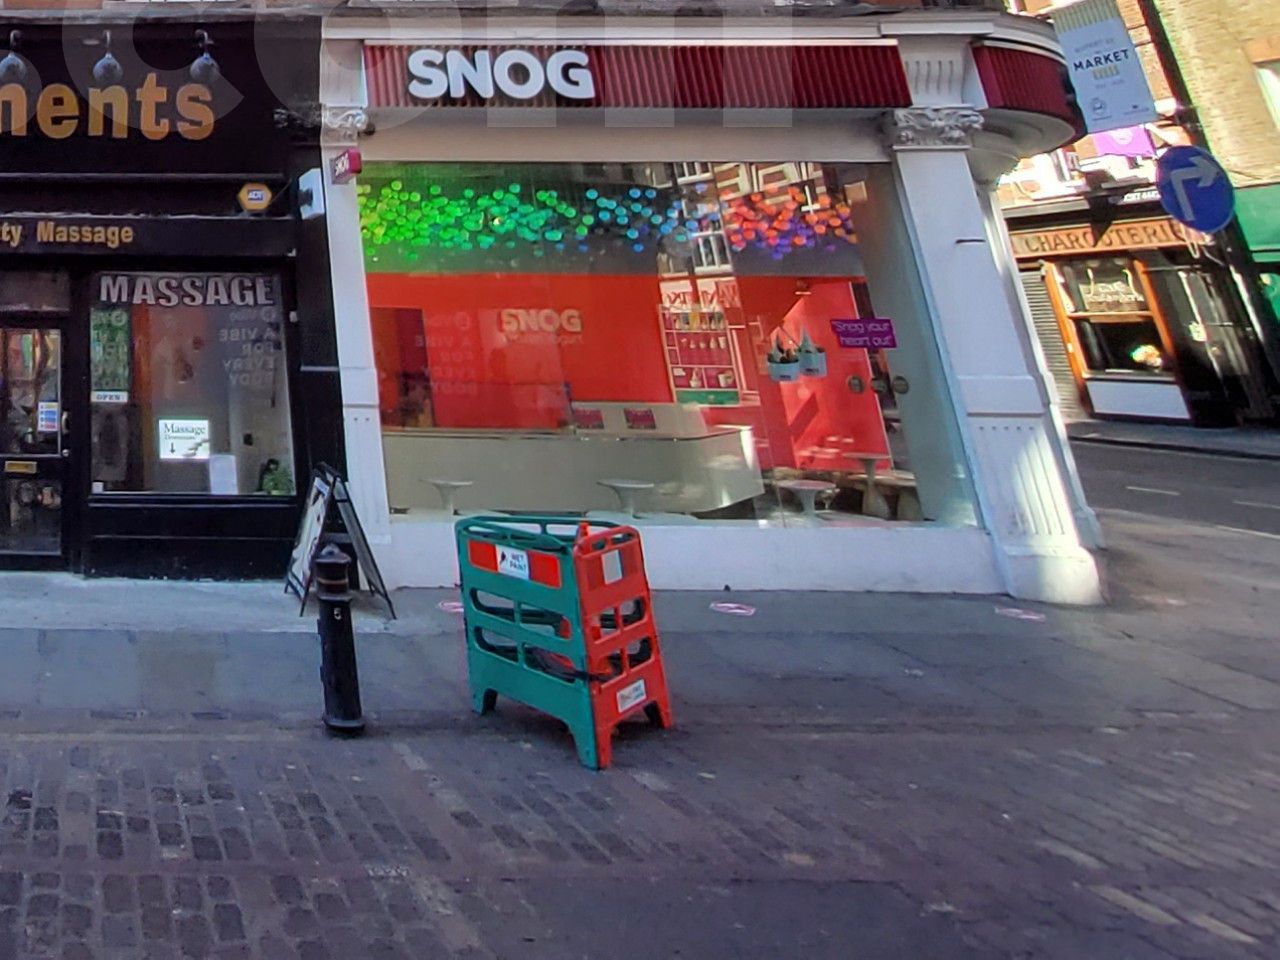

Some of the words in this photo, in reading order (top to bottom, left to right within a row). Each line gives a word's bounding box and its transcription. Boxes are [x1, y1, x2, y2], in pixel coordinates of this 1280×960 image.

[1073, 49, 1129, 71] MARKET
[408, 49, 596, 99] SNOG
[36, 220, 134, 249] Massage
[99, 274, 274, 307] MASSAGE
[501, 308, 582, 332] SNOG
[95, 393, 121, 401] OPEN
[163, 423, 206, 436] Massage
